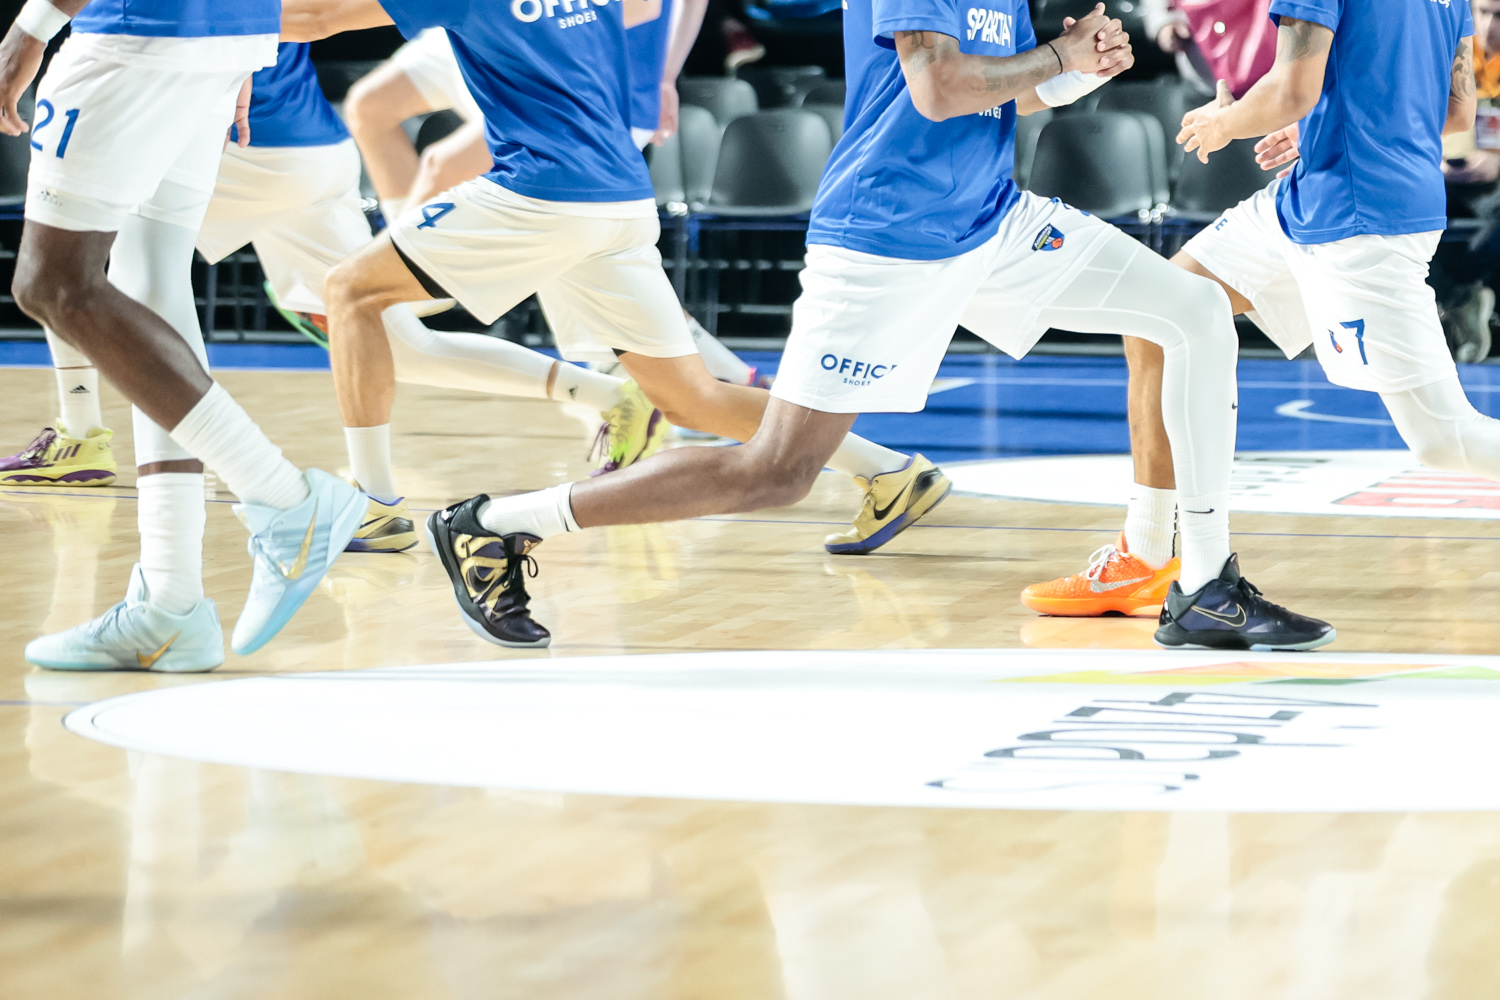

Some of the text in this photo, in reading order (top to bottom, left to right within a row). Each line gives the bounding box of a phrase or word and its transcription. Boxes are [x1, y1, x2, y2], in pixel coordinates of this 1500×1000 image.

[558, 10, 597, 29] SHOES
[30, 98, 80, 159] 21
[820, 353, 898, 379] OFFIC
